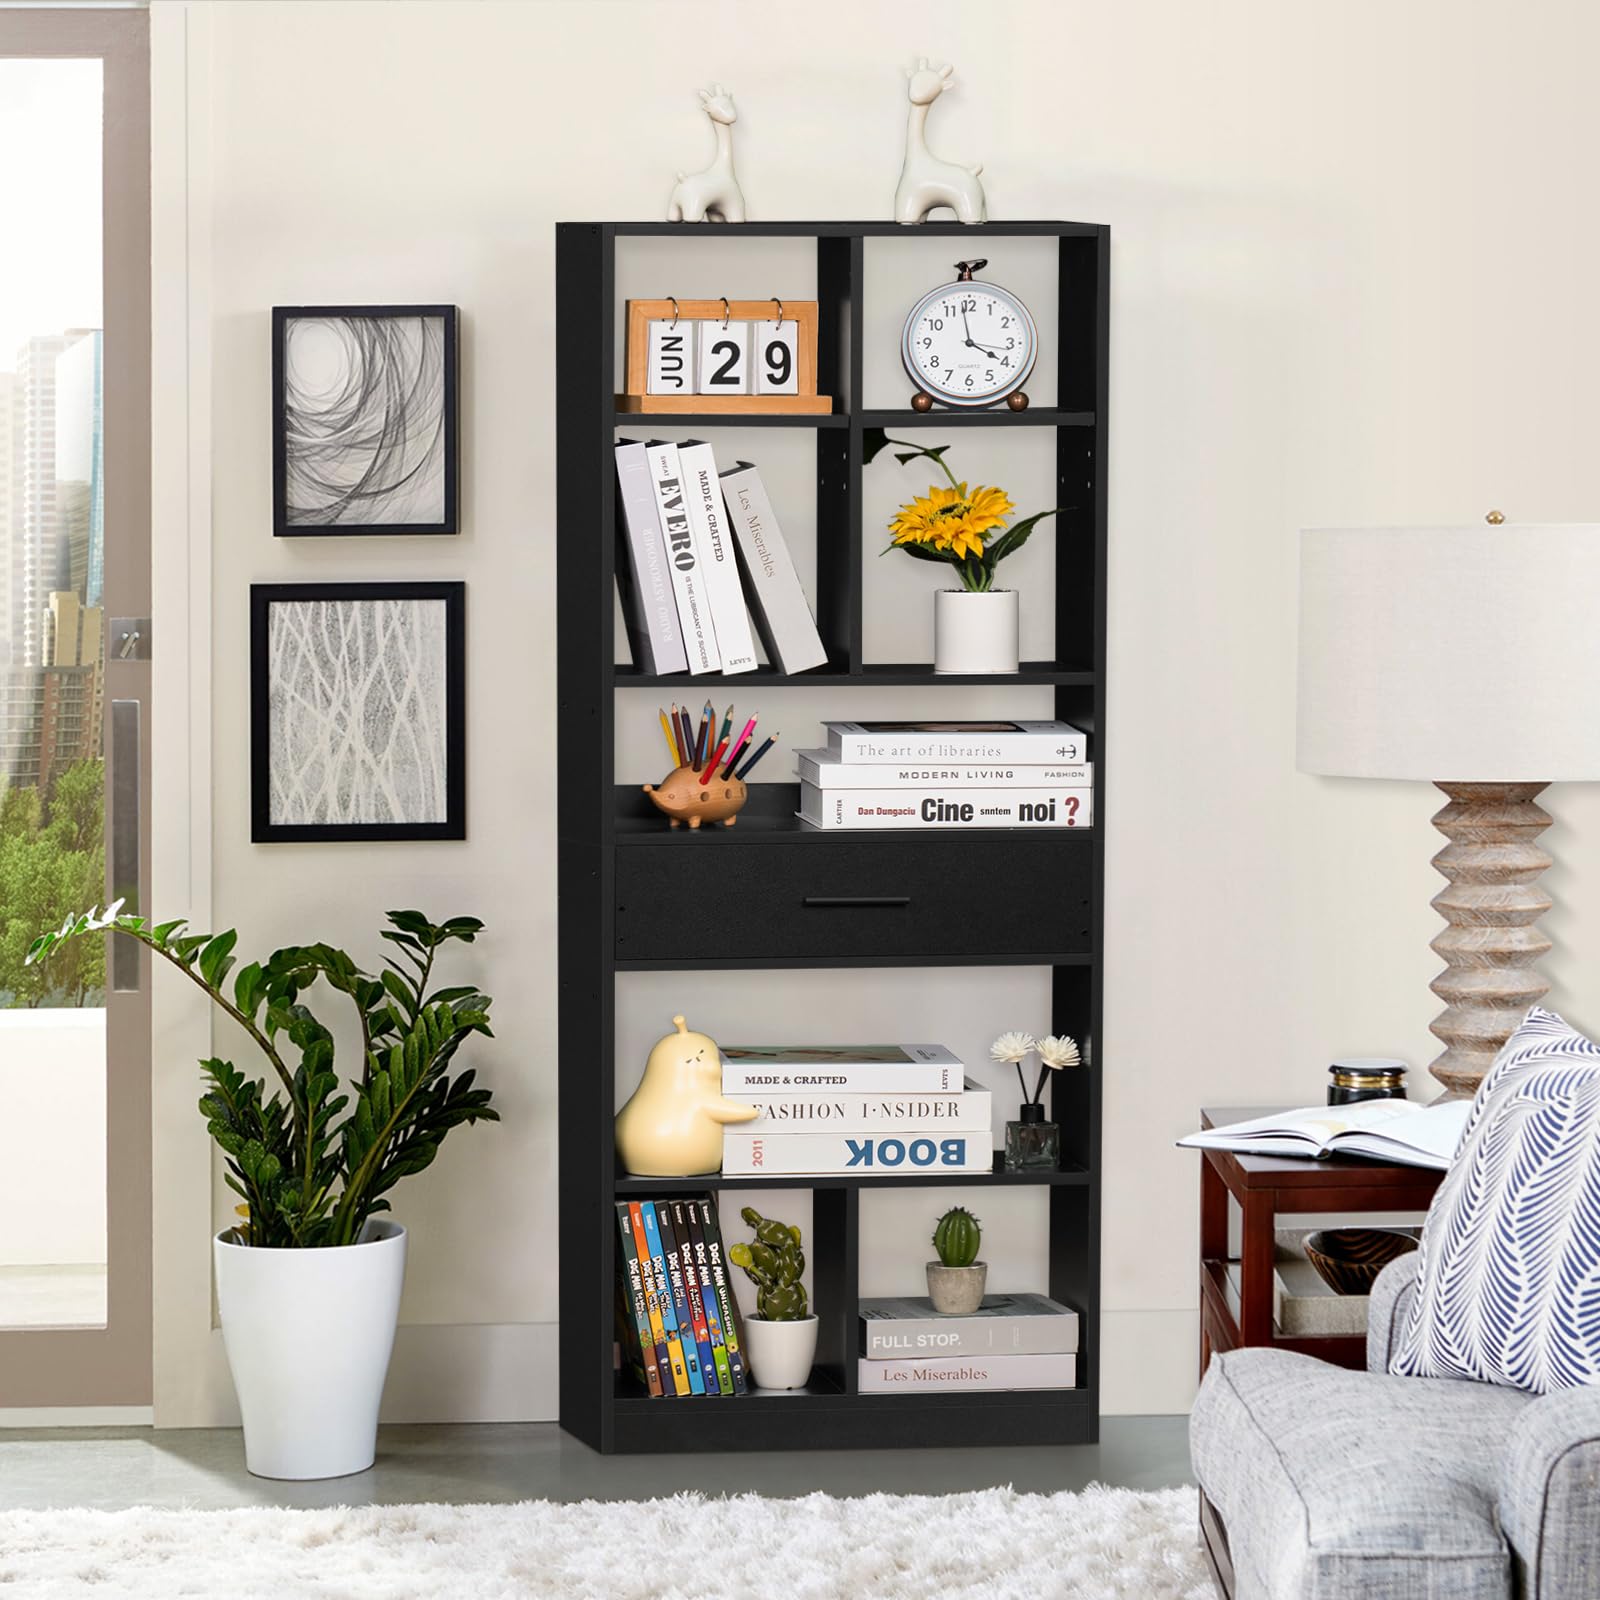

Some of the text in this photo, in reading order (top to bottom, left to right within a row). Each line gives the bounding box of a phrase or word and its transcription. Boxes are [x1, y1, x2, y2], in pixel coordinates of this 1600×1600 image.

[944, 305, 956, 317] 11
[963, 299, 976, 312] 12
[987, 304, 993, 316] 1
[928, 319, 943, 331] 10
[1001, 317, 1010, 329] 2
[923, 337, 932, 349] 9
[1006, 337, 1015, 349] 3
[661, 336, 683, 388] JUN
[709, 340, 741, 385] 2
[765, 340, 791, 385] 9
[930, 355, 939, 368] 8
[1000, 356, 1010, 368] 4
[944, 369, 954, 382] 7
[965, 374, 974, 386] 6
[985, 369, 994, 382] 5
[660, 455, 670, 477] SWEAT
[658, 477, 695, 572] EVERO
[698, 469, 724, 562] MADE & CRAFTED
[737, 488, 776, 578] Les Miserables
[698, 640, 709, 668] SUCCESS
[857, 743, 1002, 757] The art of libraries
[898, 771, 959, 779] MODERN
[967, 771, 1015, 779] LIVING
[857, 806, 875, 816] Dan
[876, 806, 916, 818] Dungaciu
[921, 797, 974, 822] Cine
[1018, 797, 1056, 821] noi
[745, 1075, 848, 1085] MADE & CRAFTED
[752, 1139, 764, 1167] 2011
[844, 1138, 966, 1167] BOOK
[667, 1251, 680, 1270] DOG
[681, 1242, 692, 1265] DOG
[694, 1242, 707, 1265] DOG
[708, 1242, 721, 1265] DOG
[684, 1265, 697, 1287] MAN
[698, 1265, 711, 1287] MAN
[712, 1265, 725, 1286] MAN
[872, 1333, 961, 1349] FULL STOP.
[883, 1367, 988, 1381] Les Miserables
